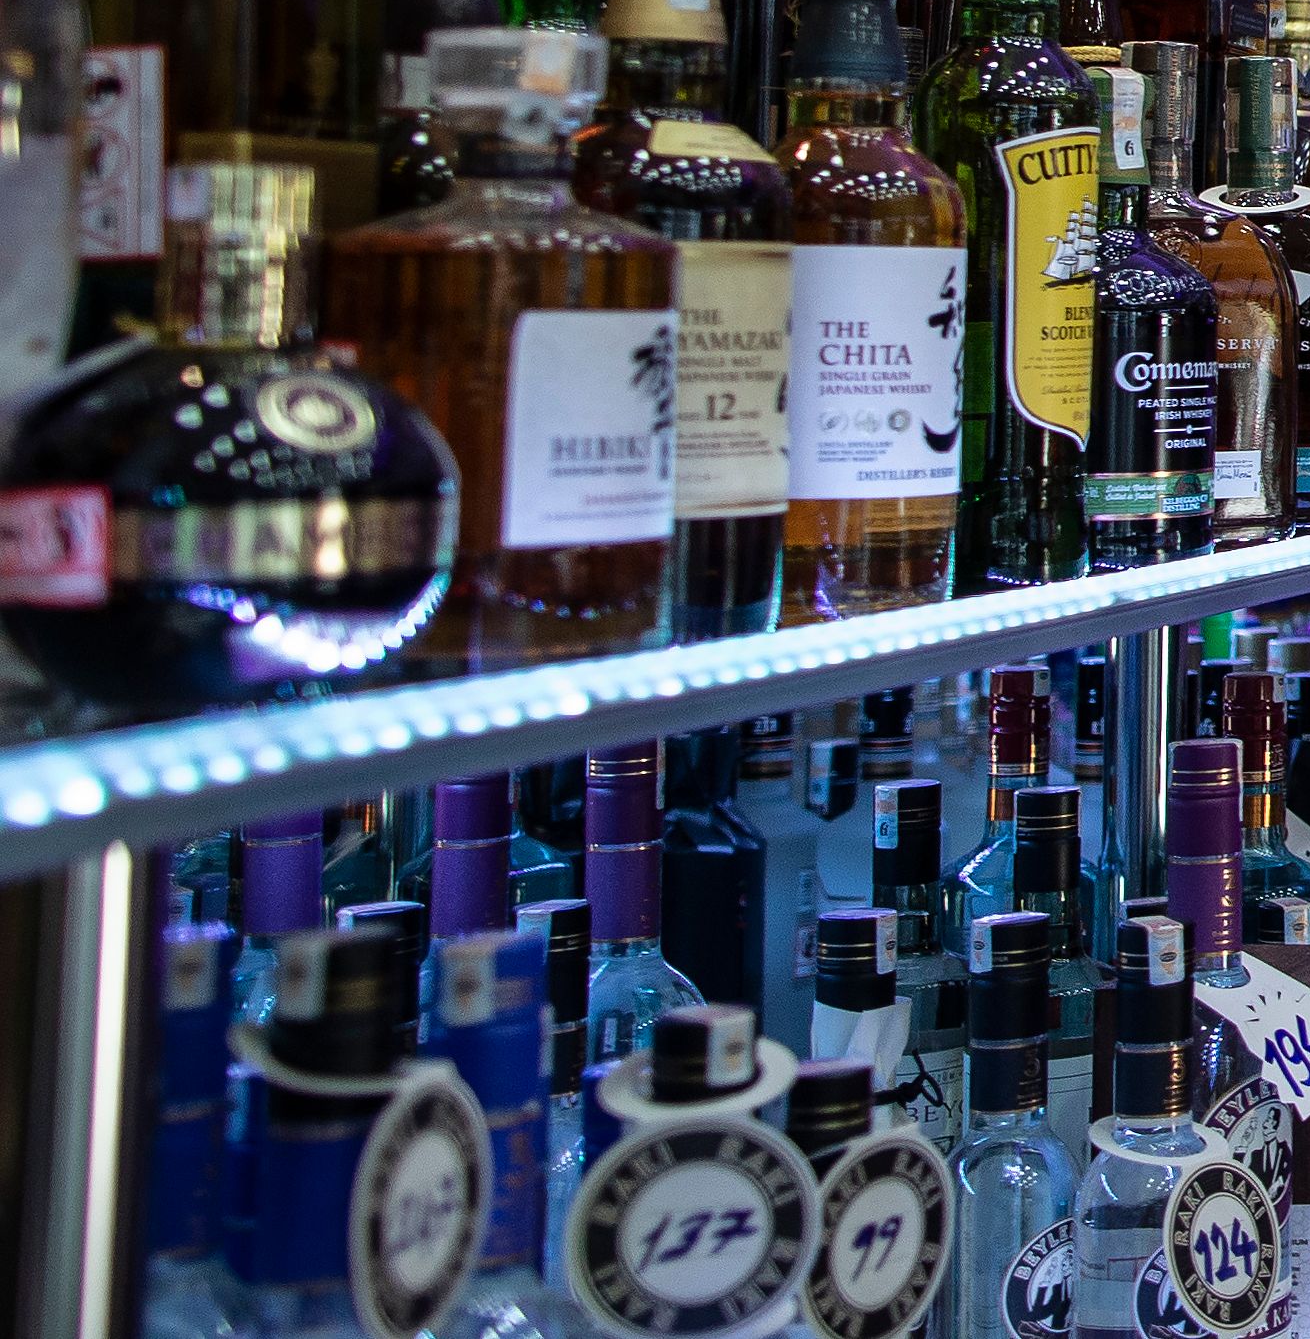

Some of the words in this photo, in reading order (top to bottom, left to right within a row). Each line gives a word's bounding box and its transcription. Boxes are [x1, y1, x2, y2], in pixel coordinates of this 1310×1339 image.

[680, 309, 720, 327] THE
[819, 321, 871, 340] THE
[1040, 325, 1086, 342] SCOTCH
[818, 343, 914, 366] CHITA
[819, 371, 869, 383] SINGLE
[871, 370, 912, 382] GRAIN
[704, 392, 739, 421] 12
[1138, 399, 1179, 409] PEATED
[1154, 410, 1181, 421] IRISH
[1164, 438, 1207, 449] ORIGINAL
[1222, 1171, 1267, 1221] RAKI
[1174, 1180, 1207, 1247] RAKI
[1193, 1216, 1260, 1288] 124
[1250, 1242, 1275, 1310] RAKI
[1184, 1273, 1232, 1323] RAKI
